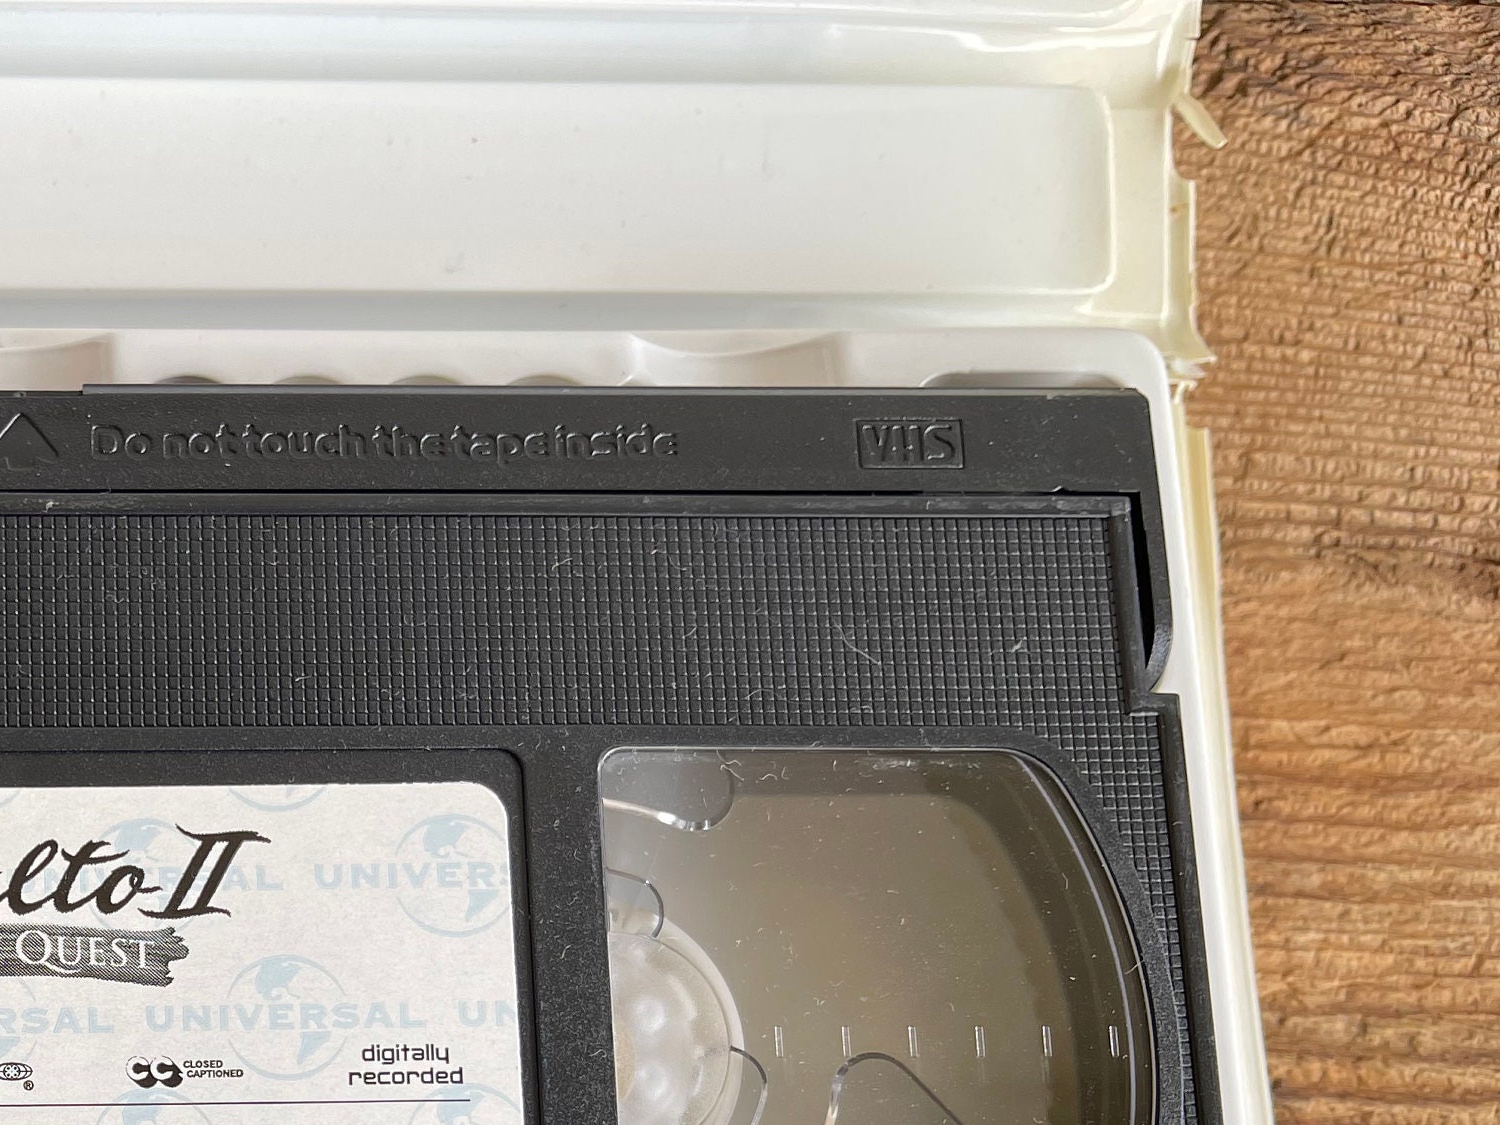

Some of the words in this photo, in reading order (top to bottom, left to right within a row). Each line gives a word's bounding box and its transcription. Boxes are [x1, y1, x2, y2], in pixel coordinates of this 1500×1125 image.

[90, 424, 151, 460] Do
[162, 423, 237, 459] not
[240, 423, 367, 460] touch
[371, 424, 446, 460] the
[449, 424, 550, 466] tape
[553, 423, 678, 460] inside
[861, 424, 956, 461] VHS
[16, 929, 156, 973] QUEST
[145, 1001, 428, 1032] UNIVERSAL
[182, 1059, 224, 1069] CLOSED
[361, 1043, 450, 1065] digitally
[186, 1068, 244, 1078] CAPTIONED
[348, 1067, 464, 1086] recorded
